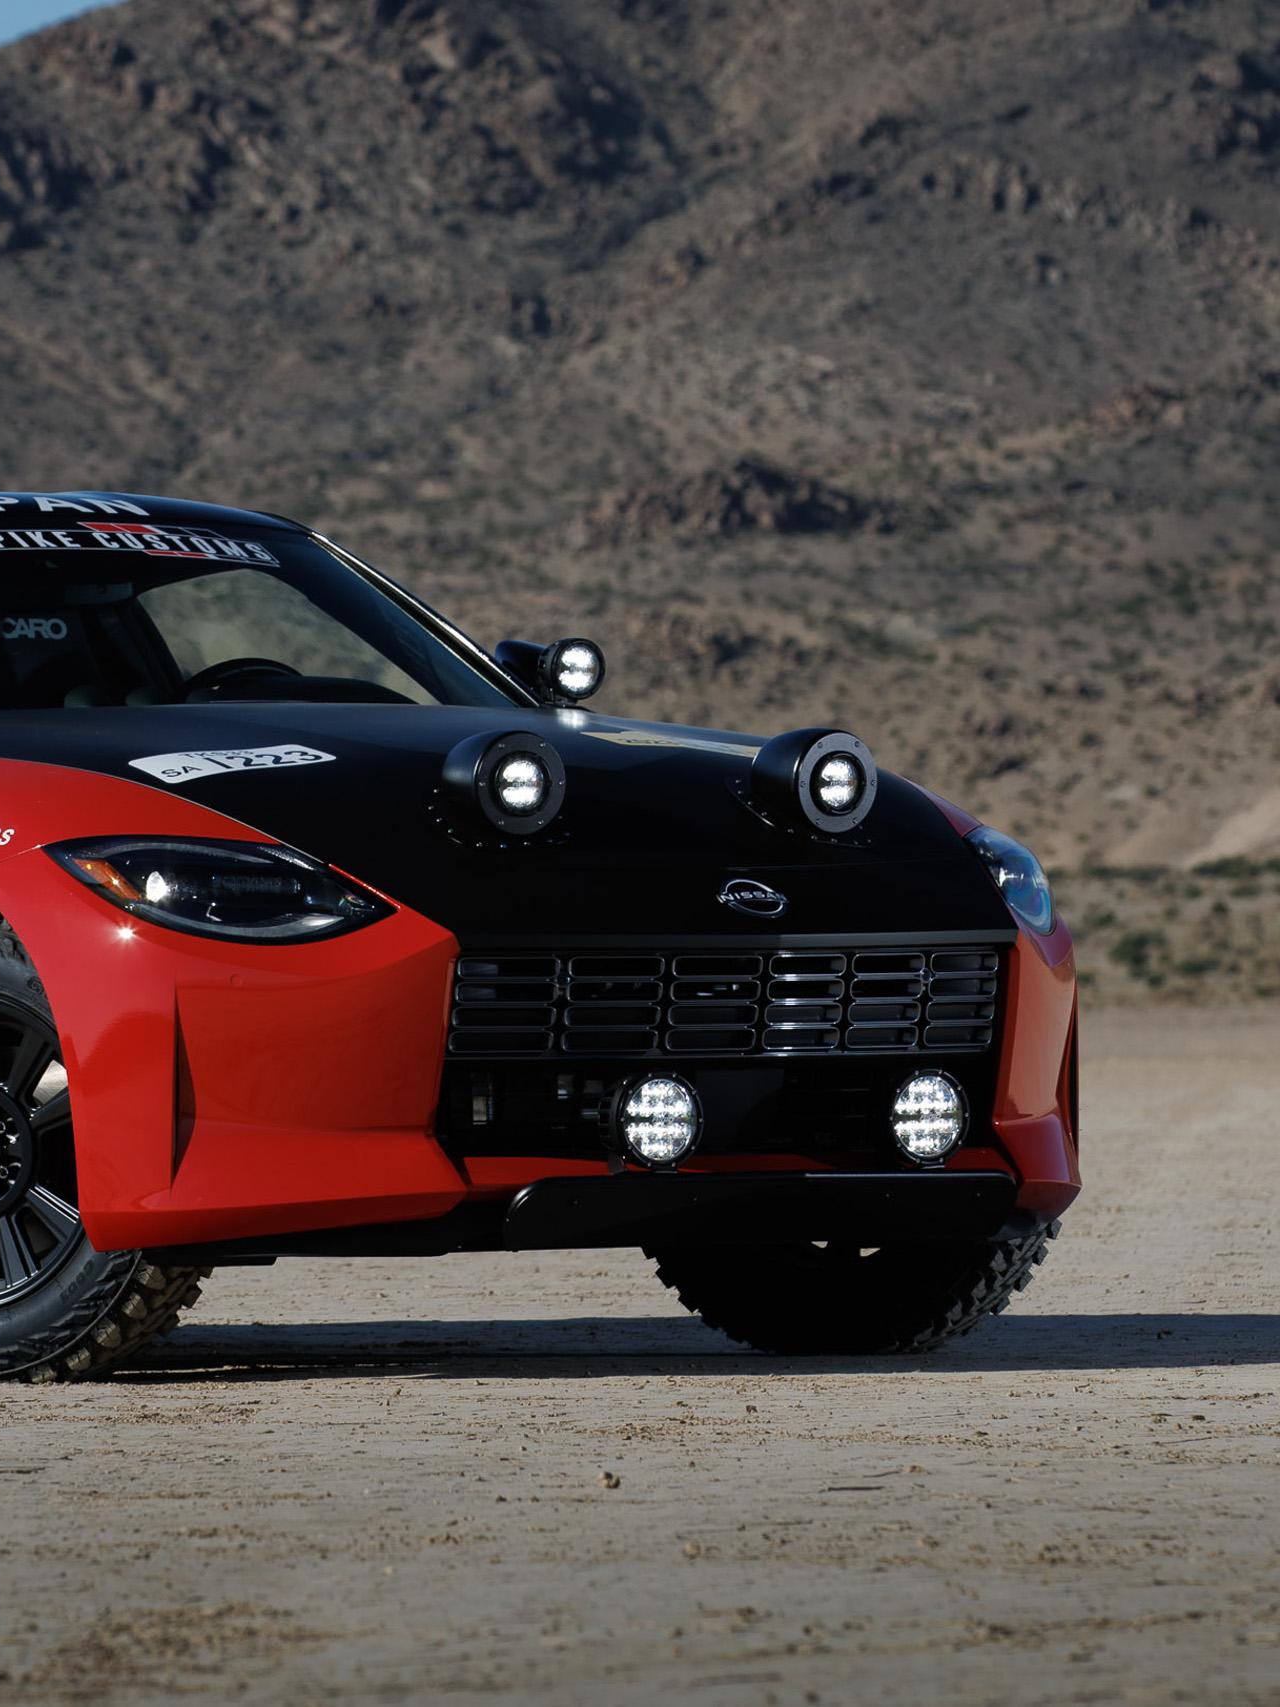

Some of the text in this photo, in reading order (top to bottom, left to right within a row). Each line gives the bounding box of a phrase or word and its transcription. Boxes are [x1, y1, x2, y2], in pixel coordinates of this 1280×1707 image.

[91, 531, 273, 561] CUSTOMS
[161, 750, 323, 779] SA 1223
[718, 891, 789, 904] NISSAN
